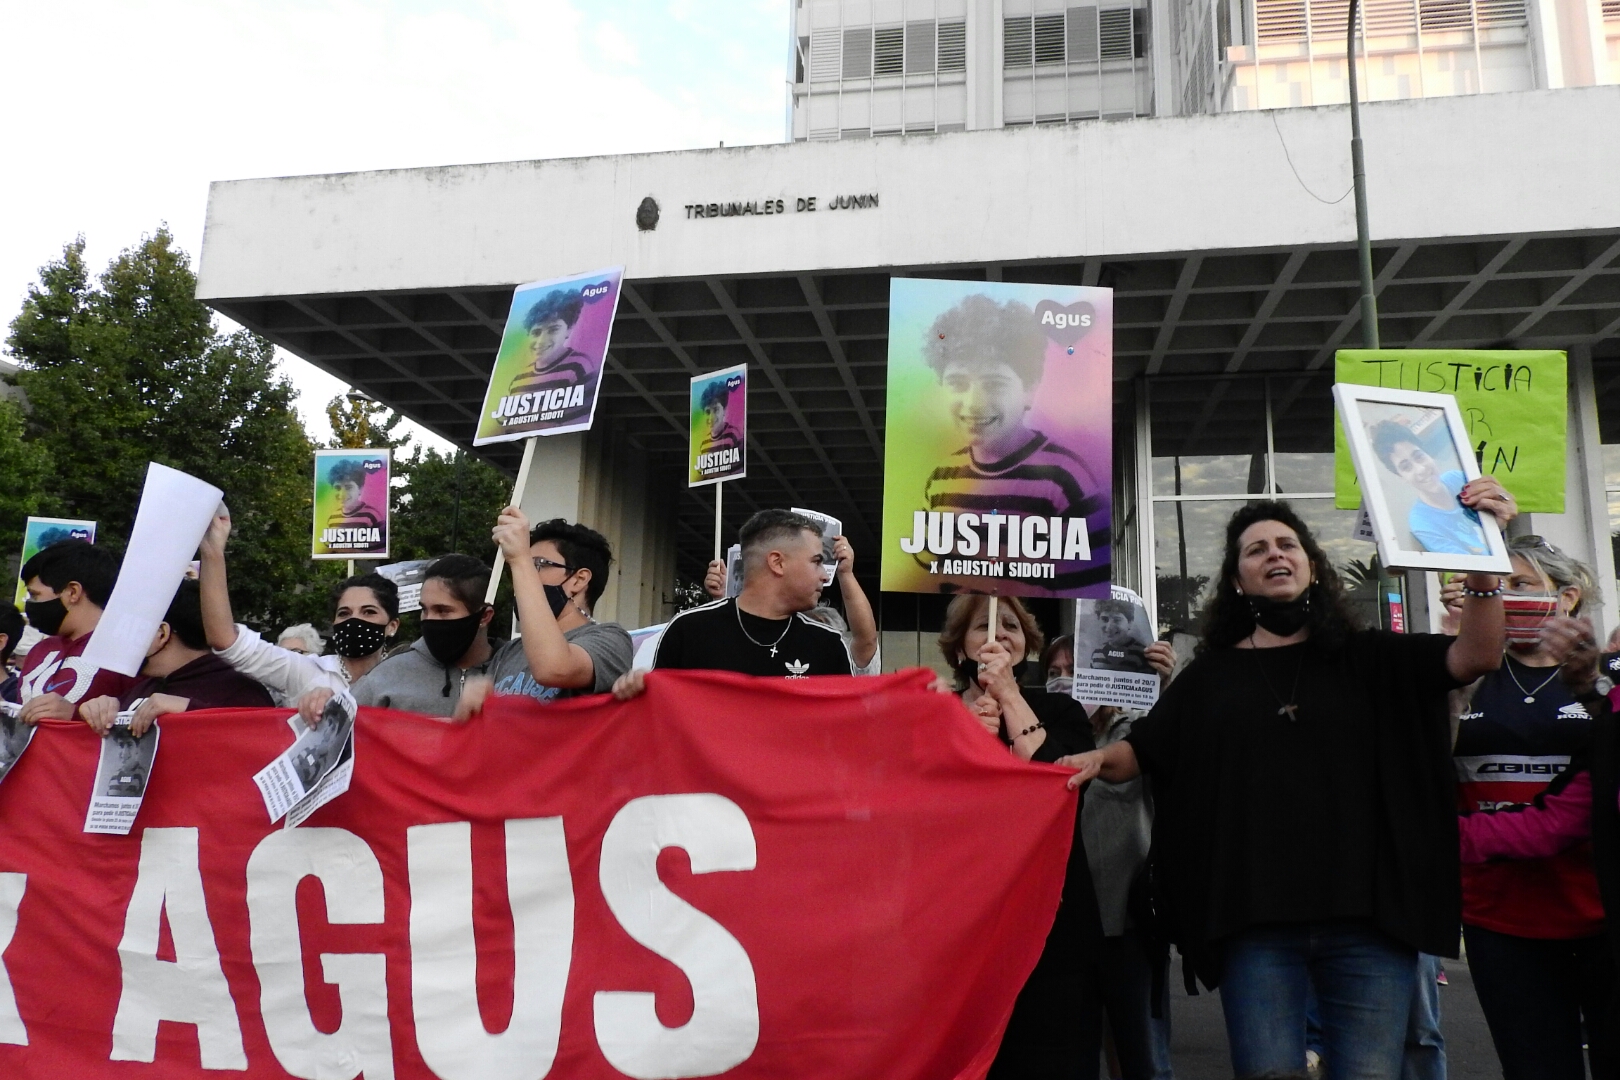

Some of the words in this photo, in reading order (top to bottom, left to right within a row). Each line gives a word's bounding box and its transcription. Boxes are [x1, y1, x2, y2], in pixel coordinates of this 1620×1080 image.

[685, 200, 784, 219] TRIBUNALES
[796, 196, 817, 212] DE
[829, 193, 879, 210] JUNIN
[582, 285, 608, 298] Agus
[1041, 310, 1092, 330] Agus
[727, 379, 741, 388] Agus
[491, 384, 585, 419] JUSTICIA
[508, 413, 539, 426] AGUSTIN
[540, 410, 565, 421] SIDOTI
[364, 462, 382, 470] Agus
[694, 447, 740, 470] JUSTICIA
[71, 531, 87, 539] Agus
[319, 527, 381, 543] JUSTICIA
[900, 510, 1092, 561] JUSTICIA
[929, 561, 938, 574] x
[943, 559, 1004, 577] AGUSTIN
[1008, 562, 1055, 579] SIDOTI
[1108, 650, 1125, 658] AGUS
[1076, 673, 1111, 682] Marchamos
[1113, 675, 1133, 684] juntos
[110, 793, 760, 1080] AGUS
